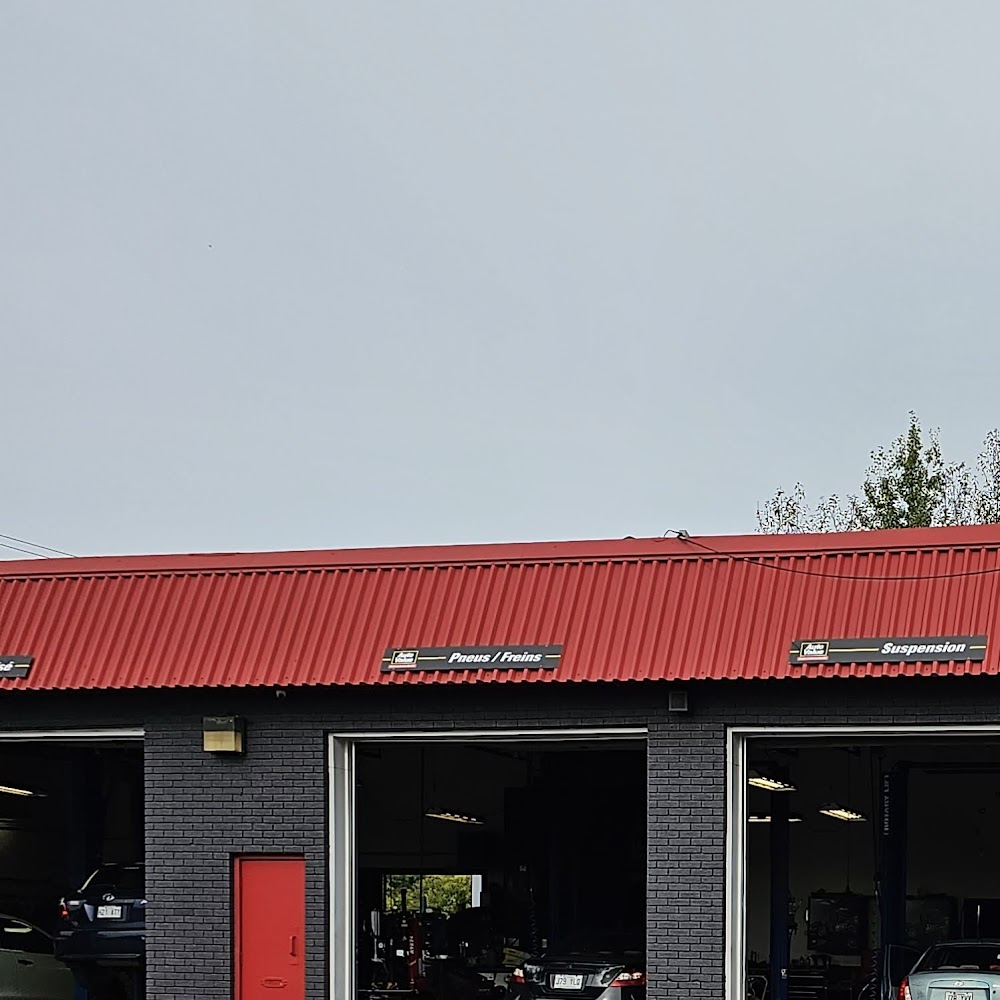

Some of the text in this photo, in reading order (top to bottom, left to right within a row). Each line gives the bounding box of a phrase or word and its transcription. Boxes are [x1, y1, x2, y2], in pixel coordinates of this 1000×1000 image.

[880, 641, 966, 656] Suspension
[448, 652, 491, 664] Pneus
[499, 652, 543, 663] Freins
